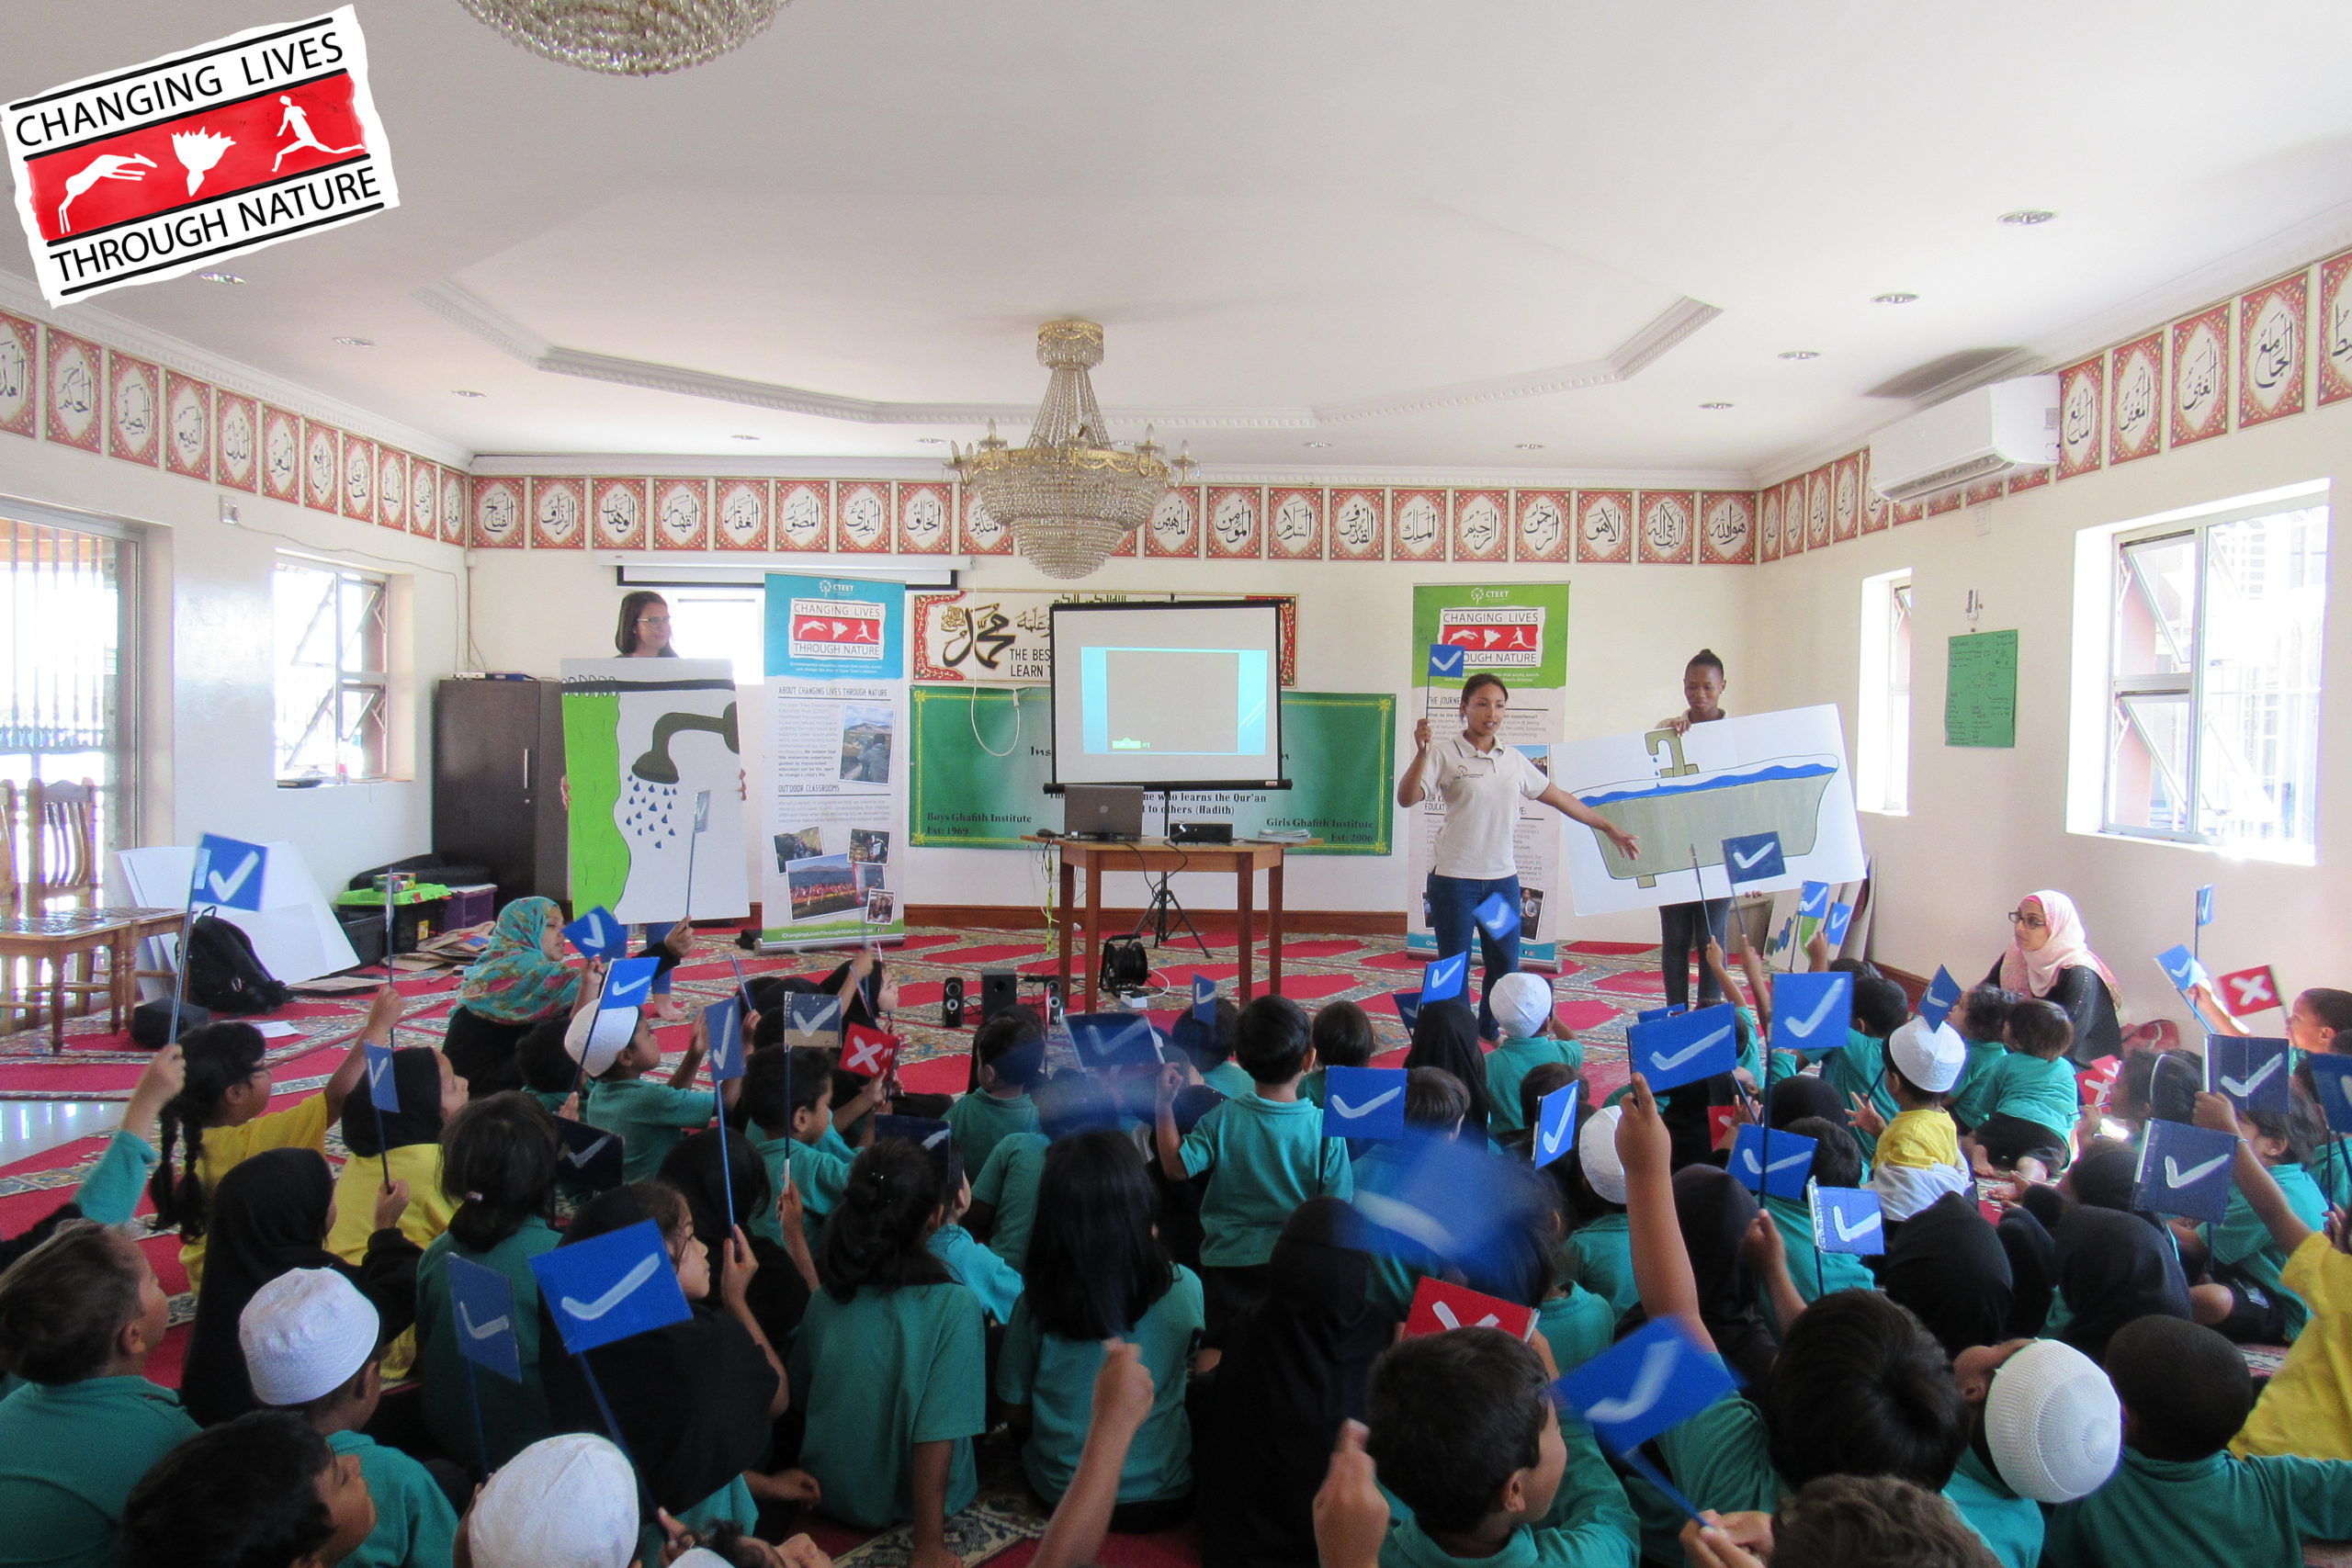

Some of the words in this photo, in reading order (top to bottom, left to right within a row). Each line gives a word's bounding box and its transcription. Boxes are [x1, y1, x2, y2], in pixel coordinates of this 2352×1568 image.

[794, 604, 849, 615] CHANGING
[854, 606, 880, 617] LIVES
[1443, 613, 1502, 623] CHANGING
[1509, 613, 1538, 622] LIVES
[794, 643, 841, 654] THROUGH
[843, 646, 879, 656] NATURE
[1010, 649, 1027, 660] THE
[1464, 653, 1492, 662] OUGH
[1496, 653, 1536, 662] NATURE
[1011, 665, 1043, 677] LEARN
[779, 686, 796, 694] ABOUT
[799, 687, 824, 695] CHANGING
[778, 784, 804, 793] OUTDOOR
[806, 784, 840, 792] CLASSROOMS
[1158, 793, 1177, 801] wo
[1181, 792, 1212, 802] learns
[1215, 793, 1230, 802] the
[1234, 793, 1266, 803] Qur'an
[1148, 806, 1158, 814] to
[1161, 806, 1193, 814] ohers
[1195, 806, 1235, 816] (Hadith)
[927, 812, 950, 824] Boys
[990, 813, 1032, 823] Institute
[1267, 818, 1291, 827] Girls
[1331, 818, 1374, 829] Institute
[947, 825, 968, 836] 1969
[1351, 832, 1373, 842] 2006
